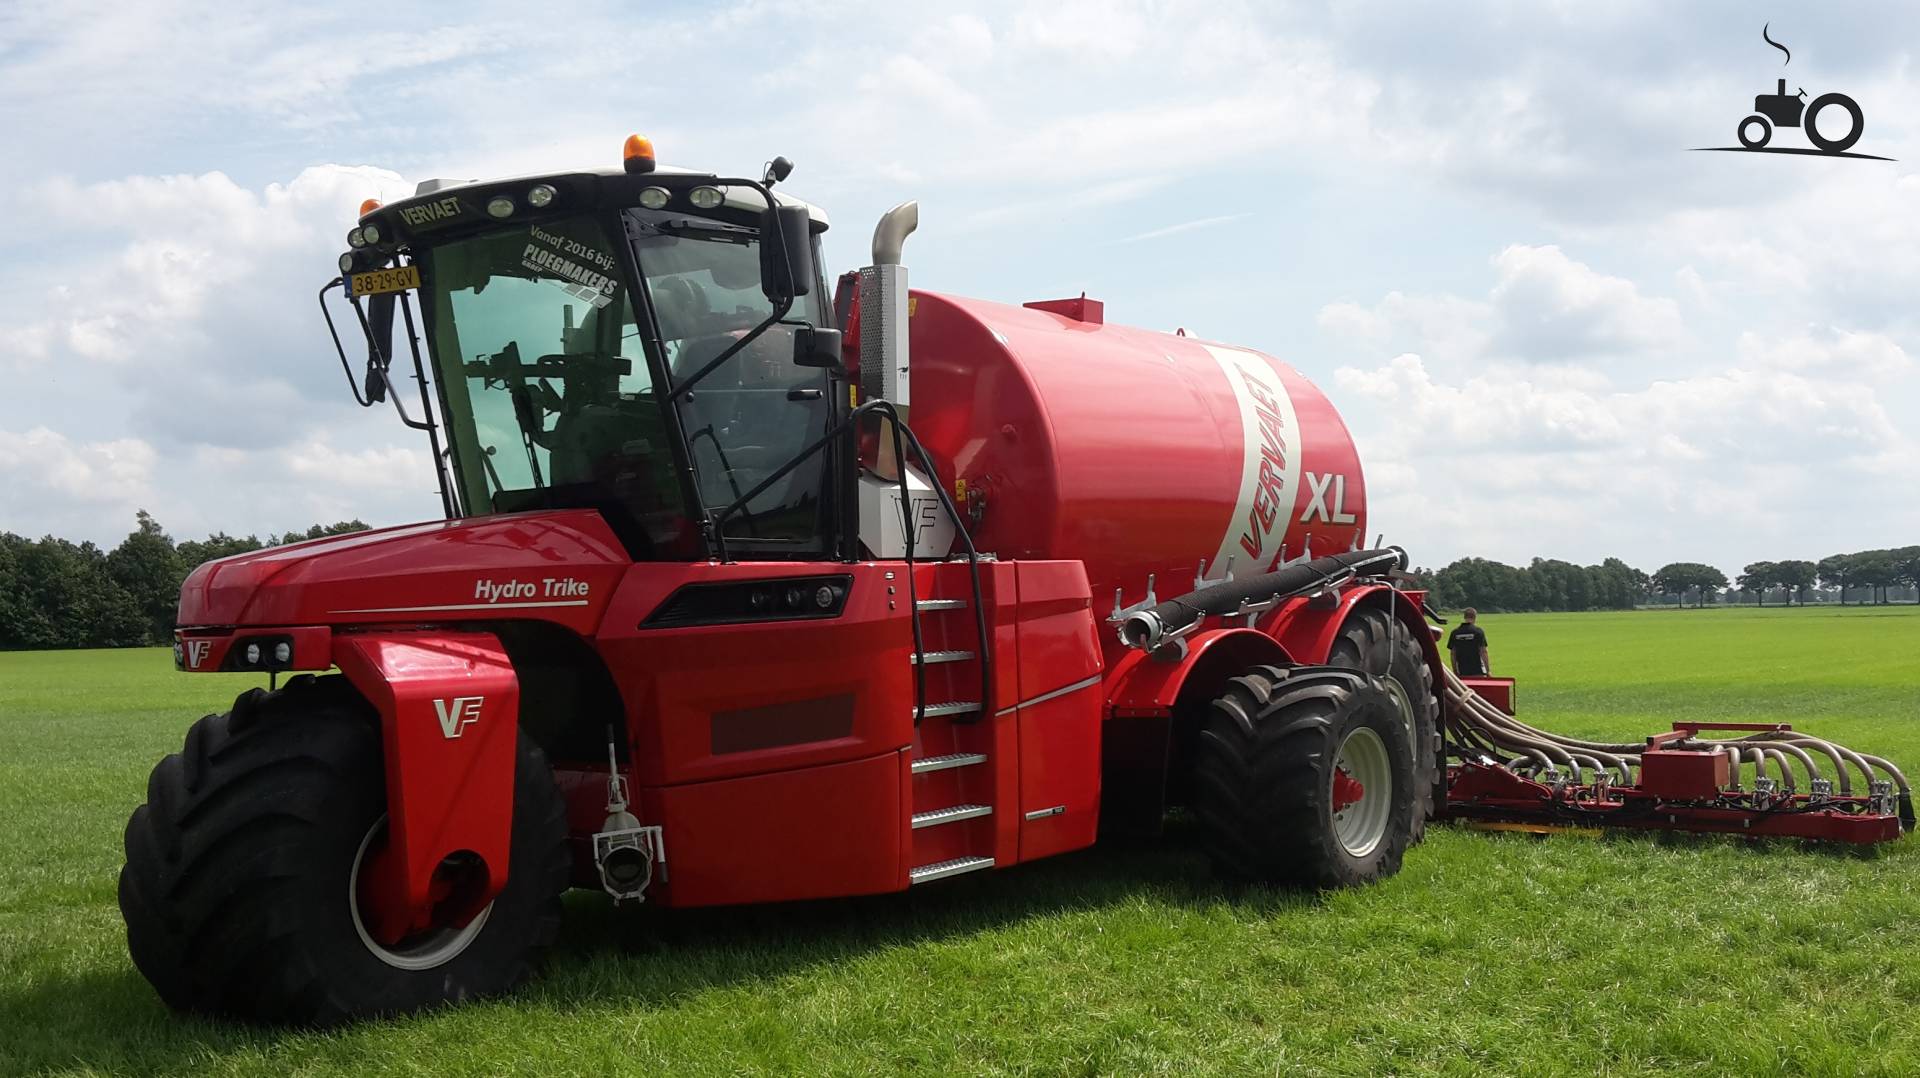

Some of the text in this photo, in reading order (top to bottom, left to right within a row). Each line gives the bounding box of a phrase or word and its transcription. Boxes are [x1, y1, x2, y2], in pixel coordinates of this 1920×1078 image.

[399, 197, 461, 225] VERVAET
[530, 224, 615, 270] Vanaf 2016 bij:
[523, 243, 618, 295] PLOEGMAKERS
[1233, 361, 1287, 560] VERVAET
[1300, 471, 1356, 524] XL
[475, 578, 589, 603] Hydro Trike
[188, 641, 211, 668] VF
[433, 697, 484, 738] VF
